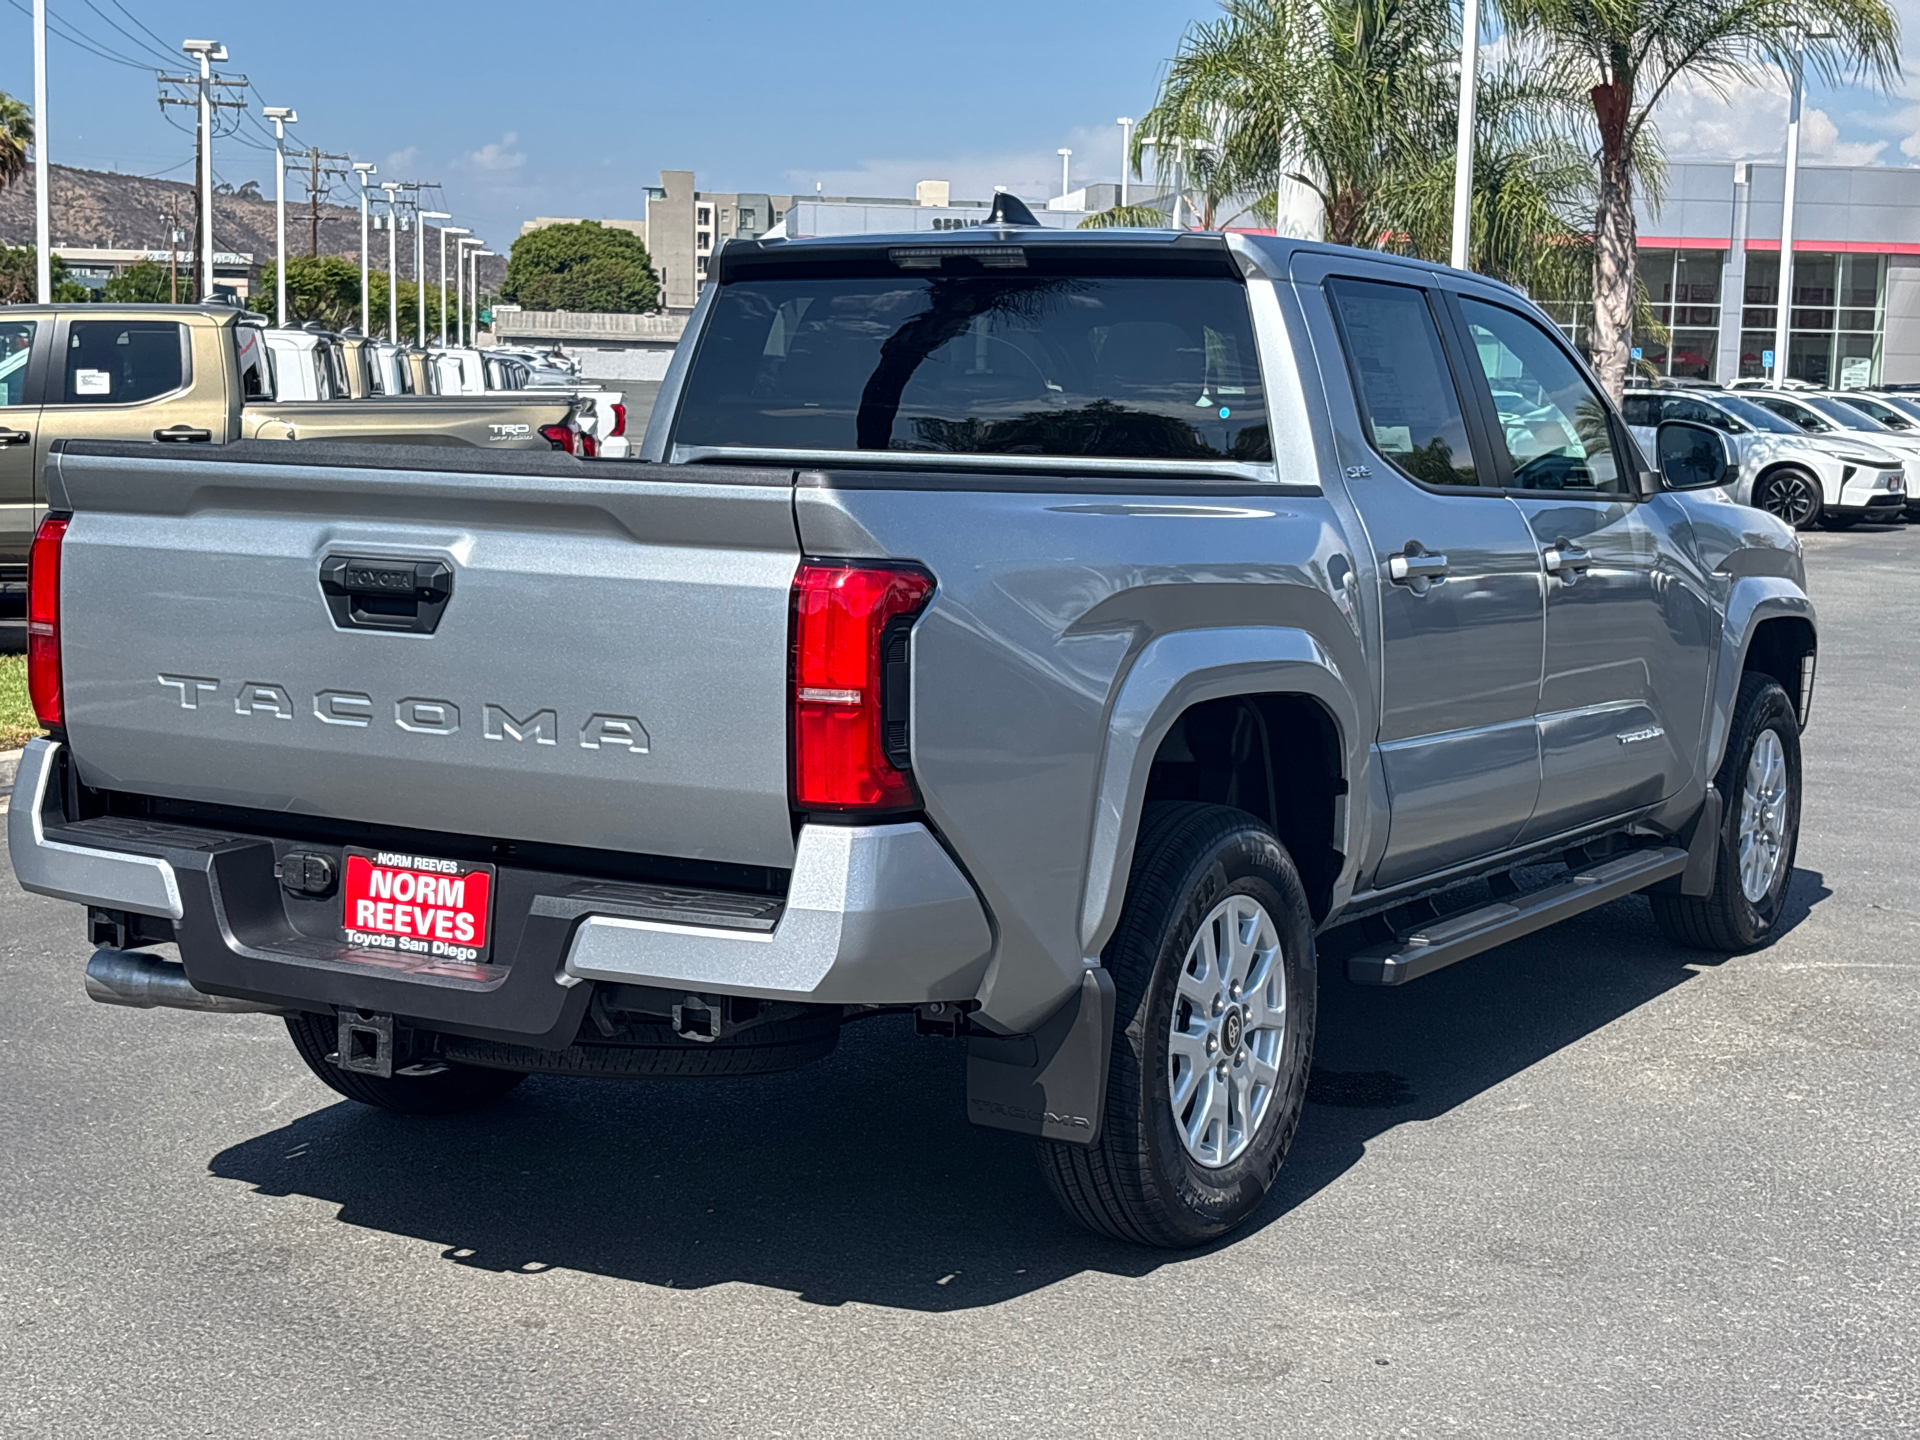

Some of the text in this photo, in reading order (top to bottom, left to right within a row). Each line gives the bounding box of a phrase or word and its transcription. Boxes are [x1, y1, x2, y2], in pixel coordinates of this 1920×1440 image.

[489, 424, 530, 435] TRD
[348, 569, 411, 588] TOYOTA
[157, 673, 651, 754] TACOMA
[377, 852, 458, 874] NORM REEVES
[369, 869, 465, 908] NORM
[356, 899, 475, 941] REEVES
[345, 929, 477, 960] Toyota San Diego
[971, 1098, 1090, 1129] TACOMA
